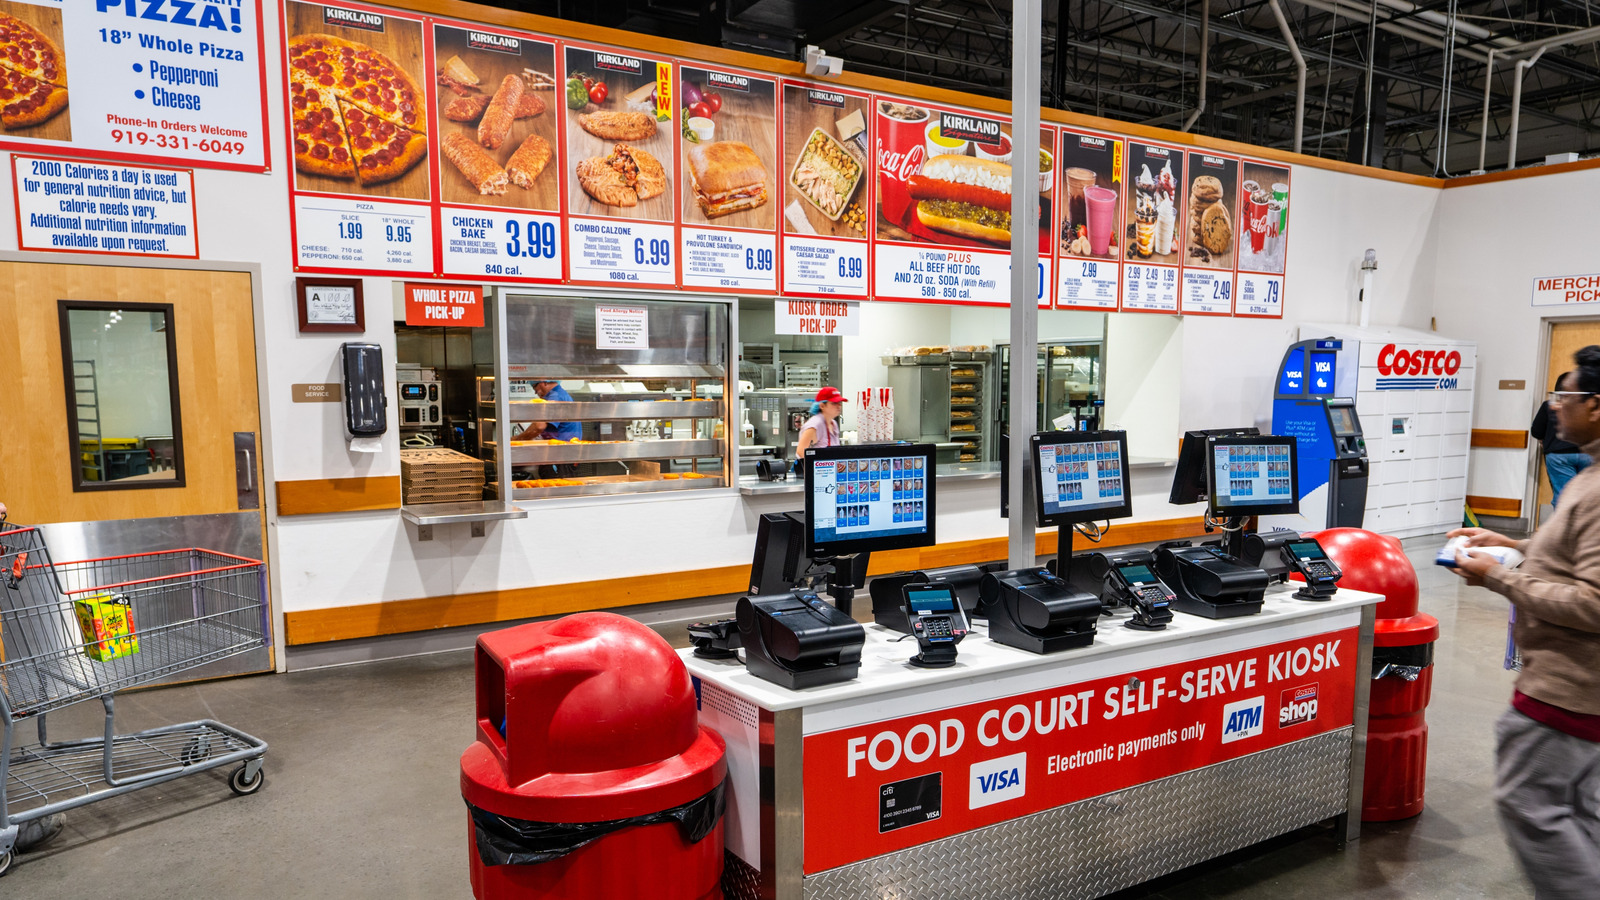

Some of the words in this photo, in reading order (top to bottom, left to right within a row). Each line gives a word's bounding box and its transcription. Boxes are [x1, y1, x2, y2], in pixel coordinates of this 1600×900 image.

[326, 8, 382, 25] KIRKLAND
[139, 33, 193, 55] Whole
[200, 42, 244, 61] Pizza
[470, 32, 518, 48] KIRKLAND
[597, 54, 640, 68] KIRKLAND
[150, 60, 219, 88] Pepperoni
[710, 73, 748, 86] KIRKLAND
[659, 66, 670, 110] NEW
[151, 87, 201, 110] Cheese
[810, 91, 843, 103] KIRKLAND
[107, 114, 158, 129] Phone-In
[161, 120, 196, 133] Orders
[200, 124, 247, 138] Welcome
[943, 115, 998, 135] KIRKLAND
[111, 129, 245, 155] 919-331-6049
[943, 129, 998, 142] Signature
[1080, 136, 1105, 146] KIRKLAND
[32, 161, 62, 177] 2000
[65, 164, 109, 181] Calories
[112, 170, 118, 182] a
[121, 170, 138, 185] day
[142, 170, 151, 184] is
[154, 172, 177, 186] used
[24, 178, 40, 193] for
[44, 180, 84, 197] general
[88, 184, 130, 199] nutrition
[133, 188, 168, 204] advice,
[172, 189, 186, 204] but
[60, 199, 96, 214] calorie
[100, 203, 129, 216] needs
[132, 207, 157, 219] vary.
[30, 213, 81, 229] Additional
[85, 216, 128, 233] nutrition
[131, 219, 186, 236] information
[338, 222, 362, 239] 1.99
[452, 216, 493, 228] CHICKEN
[575, 224, 599, 233] COMBO
[601, 226, 631, 235] CALZONE
[386, 225, 412, 242] 9.95
[461, 228, 486, 239] BAKE
[506, 220, 555, 259] 3.99
[52, 233, 98, 248] available
[102, 238, 125, 250] upon
[128, 238, 169, 252] request.
[635, 237, 670, 266] 6.99
[746, 248, 772, 270] 6.99
[926, 253, 946, 261] POUND
[947, 253, 971, 263] PLUS
[485, 264, 502, 274] 840
[505, 265, 522, 275] cal.
[610, 272, 625, 280] 1080
[839, 257, 862, 278] 6.99
[909, 261, 924, 272] ALL
[927, 263, 945, 273] BEEF
[948, 264, 962, 274] HOT
[965, 265, 980, 275] DOG
[1082, 262, 1097, 278] 2.99
[1128, 266, 1140, 279] 2.99
[1146, 268, 1158, 280] 2.49
[1164, 270, 1174, 281] 1.99
[894, 272, 911, 283] AND
[914, 274, 923, 284] 20
[925, 277, 935, 285] oz.
[938, 275, 959, 285] SODA
[961, 279, 977, 288] (With
[978, 280, 996, 289] Refill)
[1538, 276, 1600, 291] MERCH
[312, 293, 320, 301] A
[413, 289, 446, 304] WHOLE
[449, 290, 475, 304] PIZZA
[922, 287, 935, 296] 580
[944, 288, 956, 297] 850
[959, 288, 971, 298] cal.
[1213, 280, 1230, 300] 2.49
[1264, 280, 1278, 303] .79
[425, 306, 465, 320] PICK-UP
[788, 300, 817, 316] KIOSK
[820, 301, 848, 317] ORDER
[800, 318, 837, 334] PICK-UP
[1315, 362, 1330, 372] VISA
[1377, 343, 1462, 376] COSTCO
[1436, 378, 1458, 390] .COM
[1295, 687, 1316, 697] COSTCO
[848, 718, 965, 778] FOOD
[977, 691, 1094, 747] COURT
[1102, 658, 1257, 721] SELF-SERVE
[1267, 640, 1341, 683] KIOSK
[1280, 699, 1317, 722] shop
[1224, 705, 1262, 735] ATM
[1047, 743, 1114, 775] Electronic
[1118, 727, 1178, 761] payments
[1181, 721, 1206, 742] only
[976, 768, 1019, 794] VISA
[883, 787, 894, 795] citi
[926, 810, 939, 819] VISA
